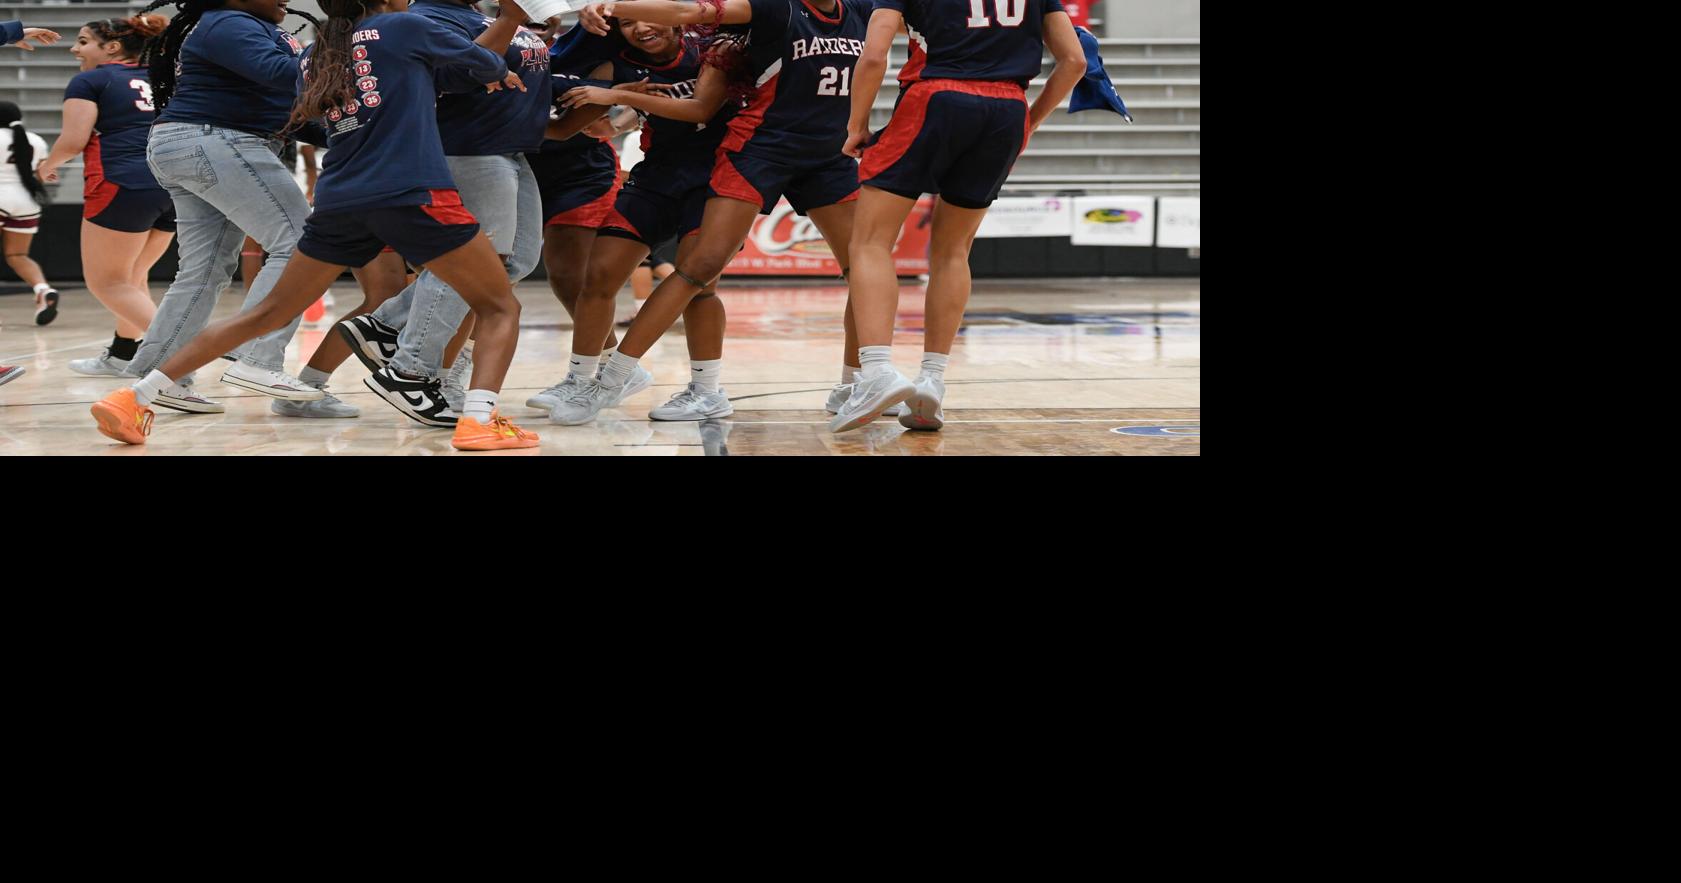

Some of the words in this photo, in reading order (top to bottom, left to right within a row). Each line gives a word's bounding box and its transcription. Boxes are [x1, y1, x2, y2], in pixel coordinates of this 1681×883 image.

[966, 0, 1026, 28] 10
[352, 29, 380, 43] IDERS
[792, 36, 865, 61] RAIDER
[359, 65, 368, 74] 13
[362, 80, 373, 90] 23
[817, 66, 850, 96] 21
[366, 95, 378, 105] 35
